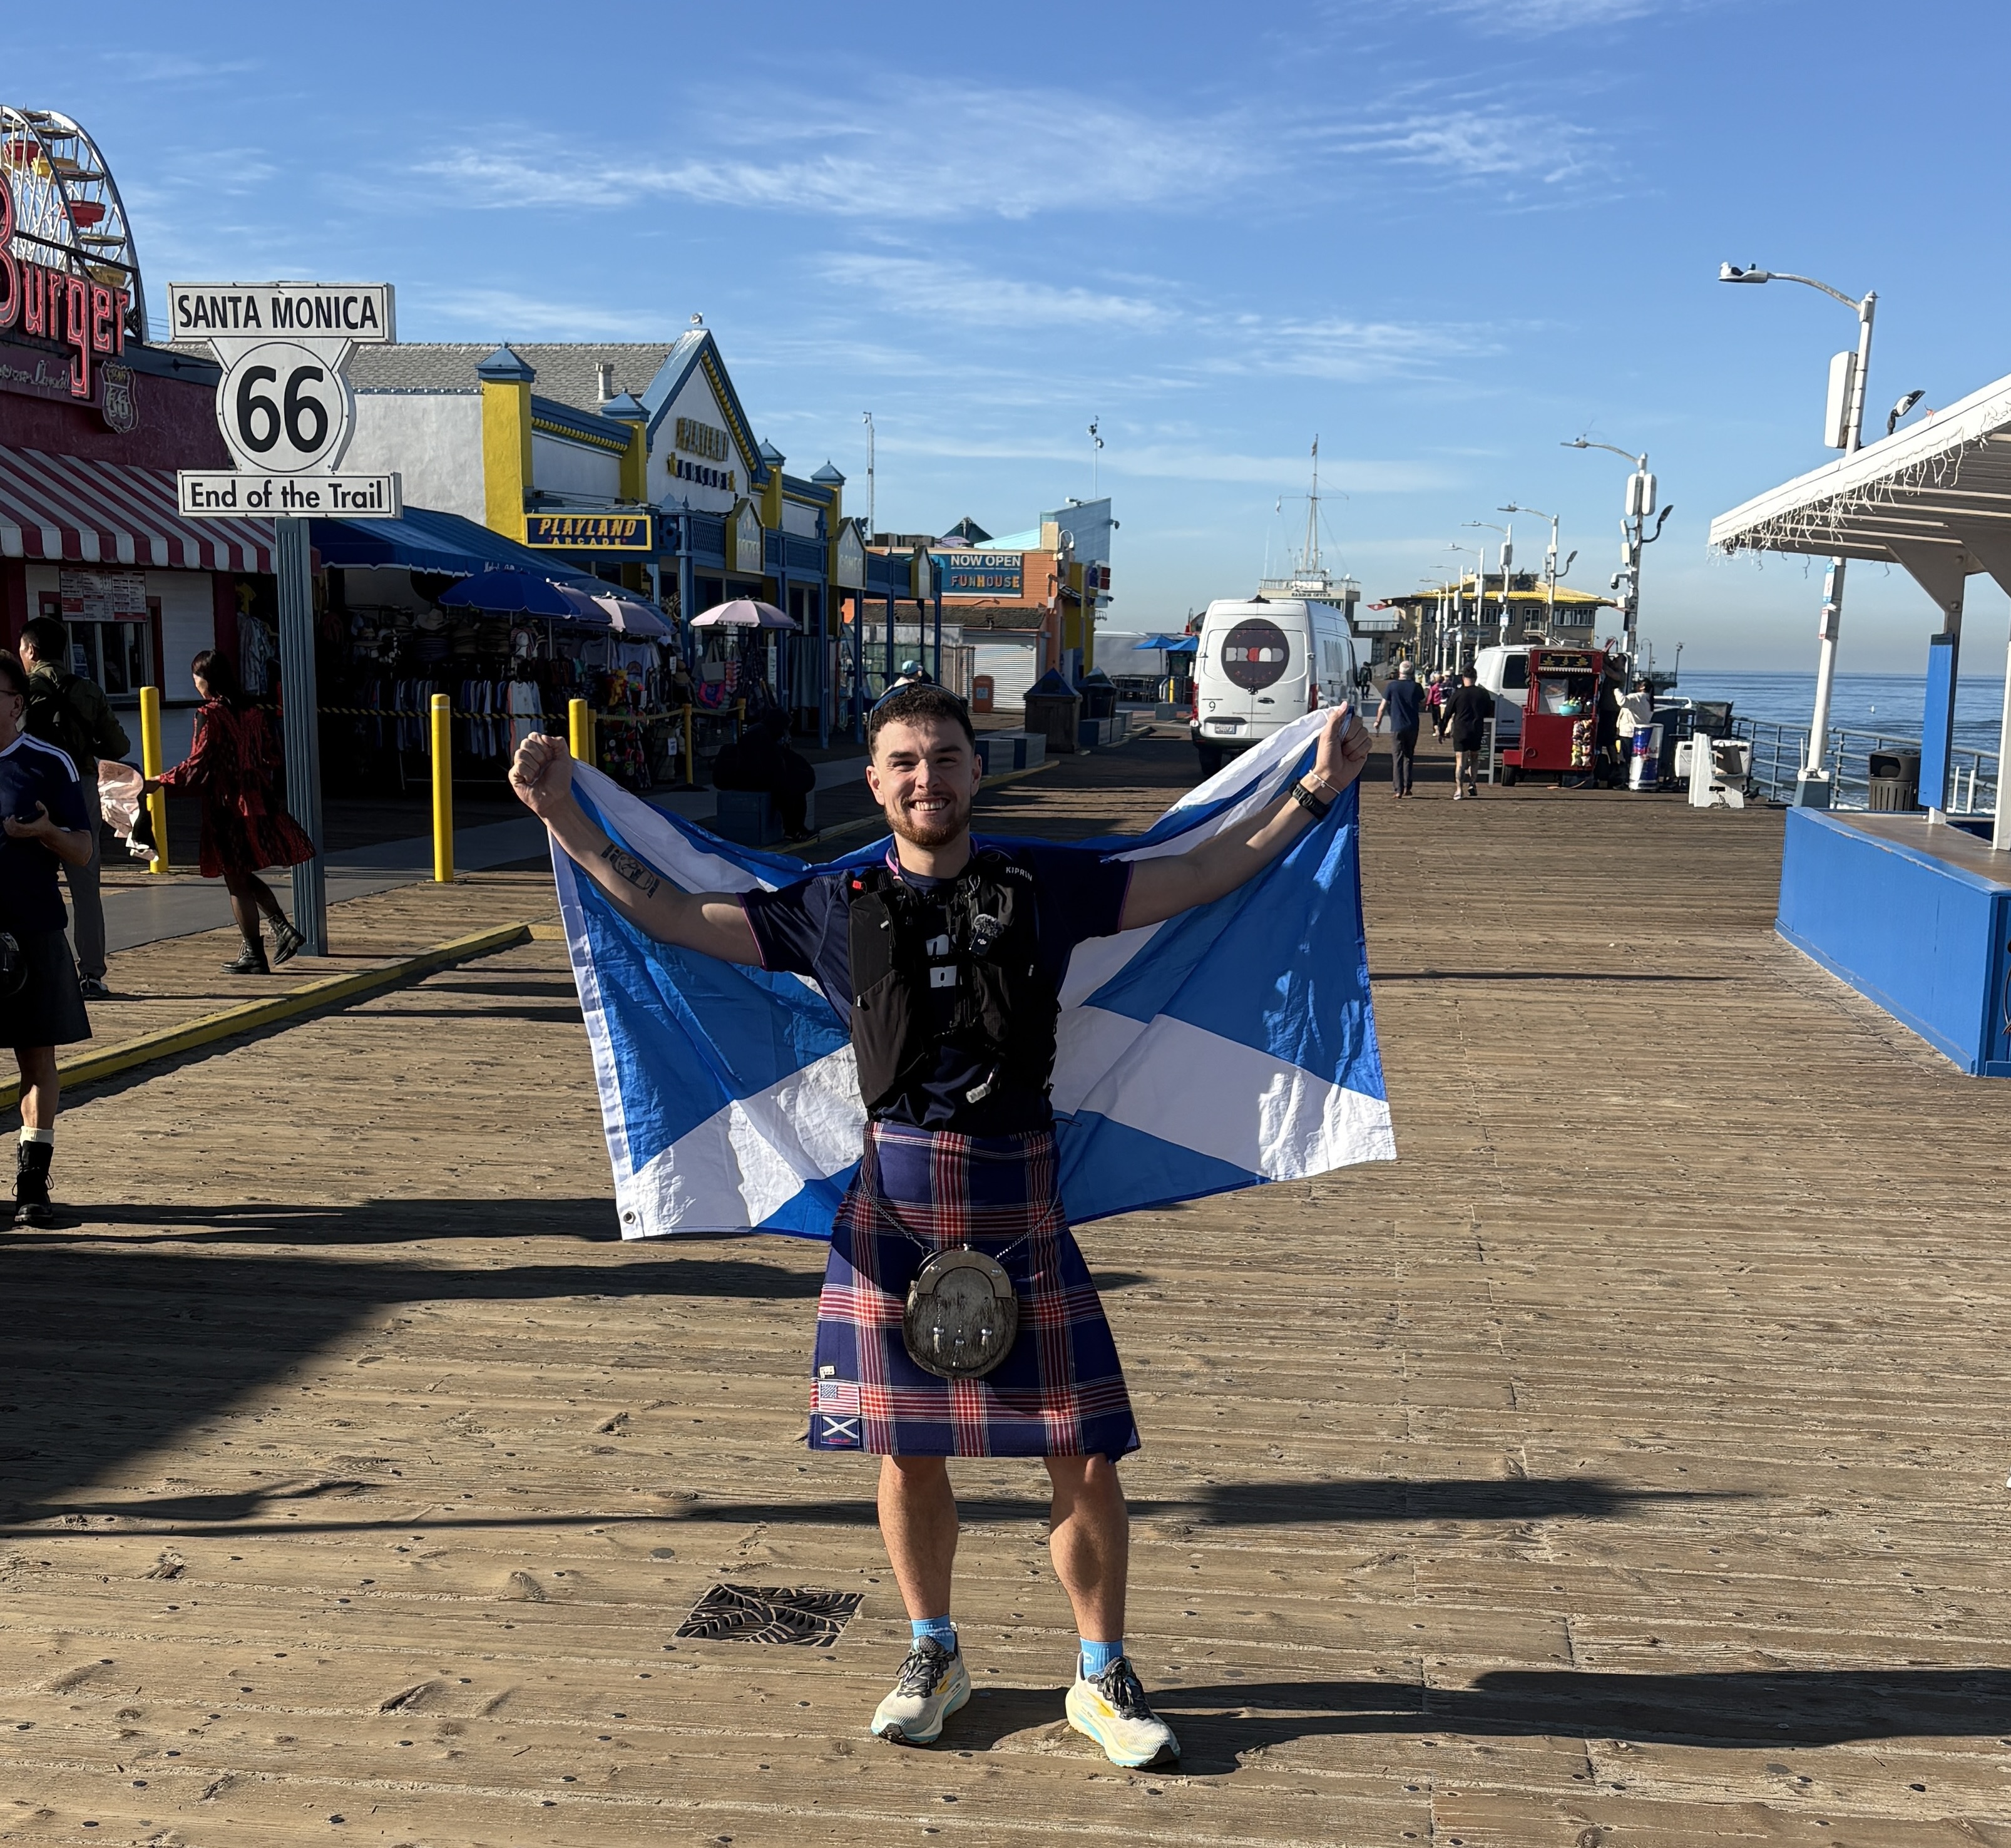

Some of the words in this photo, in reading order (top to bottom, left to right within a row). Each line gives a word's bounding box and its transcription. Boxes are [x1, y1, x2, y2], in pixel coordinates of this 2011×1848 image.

[178, 295, 262, 329] SANTA
[271, 295, 379, 330] MONICA
[237, 365, 329, 453] 66
[676, 459, 729, 490] ARCADE
[190, 480, 237, 508] End
[247, 480, 272, 508] of
[281, 480, 320, 508] the
[328, 480, 383, 509] Trail
[538, 518, 637, 536] PLAYLAND
[553, 536, 622, 546] ARCADE
[951, 555, 983, 567] NOW
[985, 555, 1021, 567] OPEN
[951, 575, 1020, 588] FUNHOUSE
[1209, 701, 1216, 712] 9
[1006, 866, 1033, 881] KIPRUN
